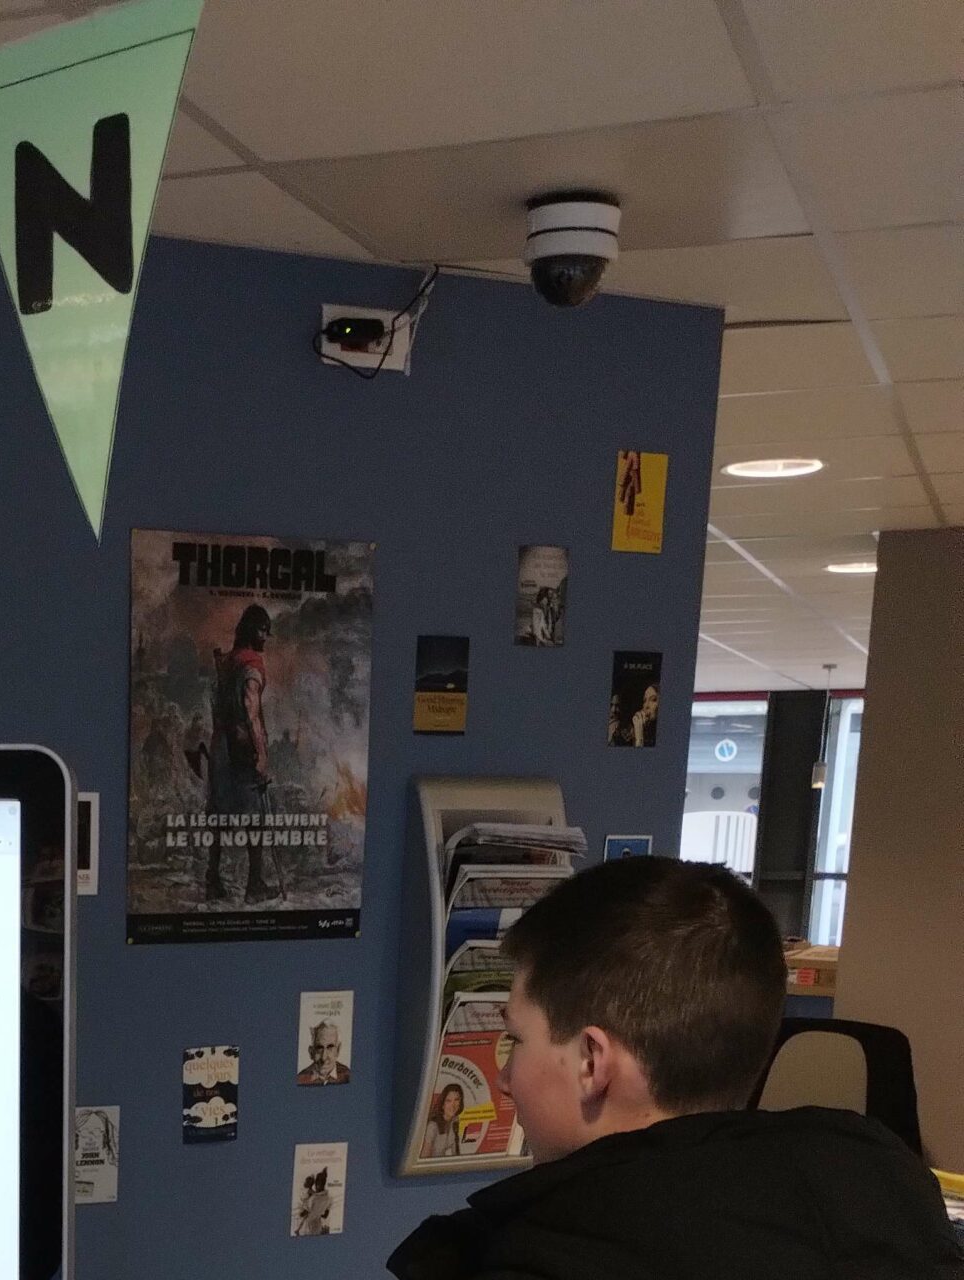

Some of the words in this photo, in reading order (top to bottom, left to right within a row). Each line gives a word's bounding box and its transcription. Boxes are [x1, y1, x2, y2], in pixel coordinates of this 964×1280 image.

[172, 541, 335, 592] THORGAL
[166, 814, 186, 828] LA
[189, 811, 261, 827] LÉGENDE
[264, 813, 328, 827] REVIENT
[166, 832, 188, 848] LE
[193, 832, 214, 847] 10
[220, 831, 328, 848] NOVEMBRE
